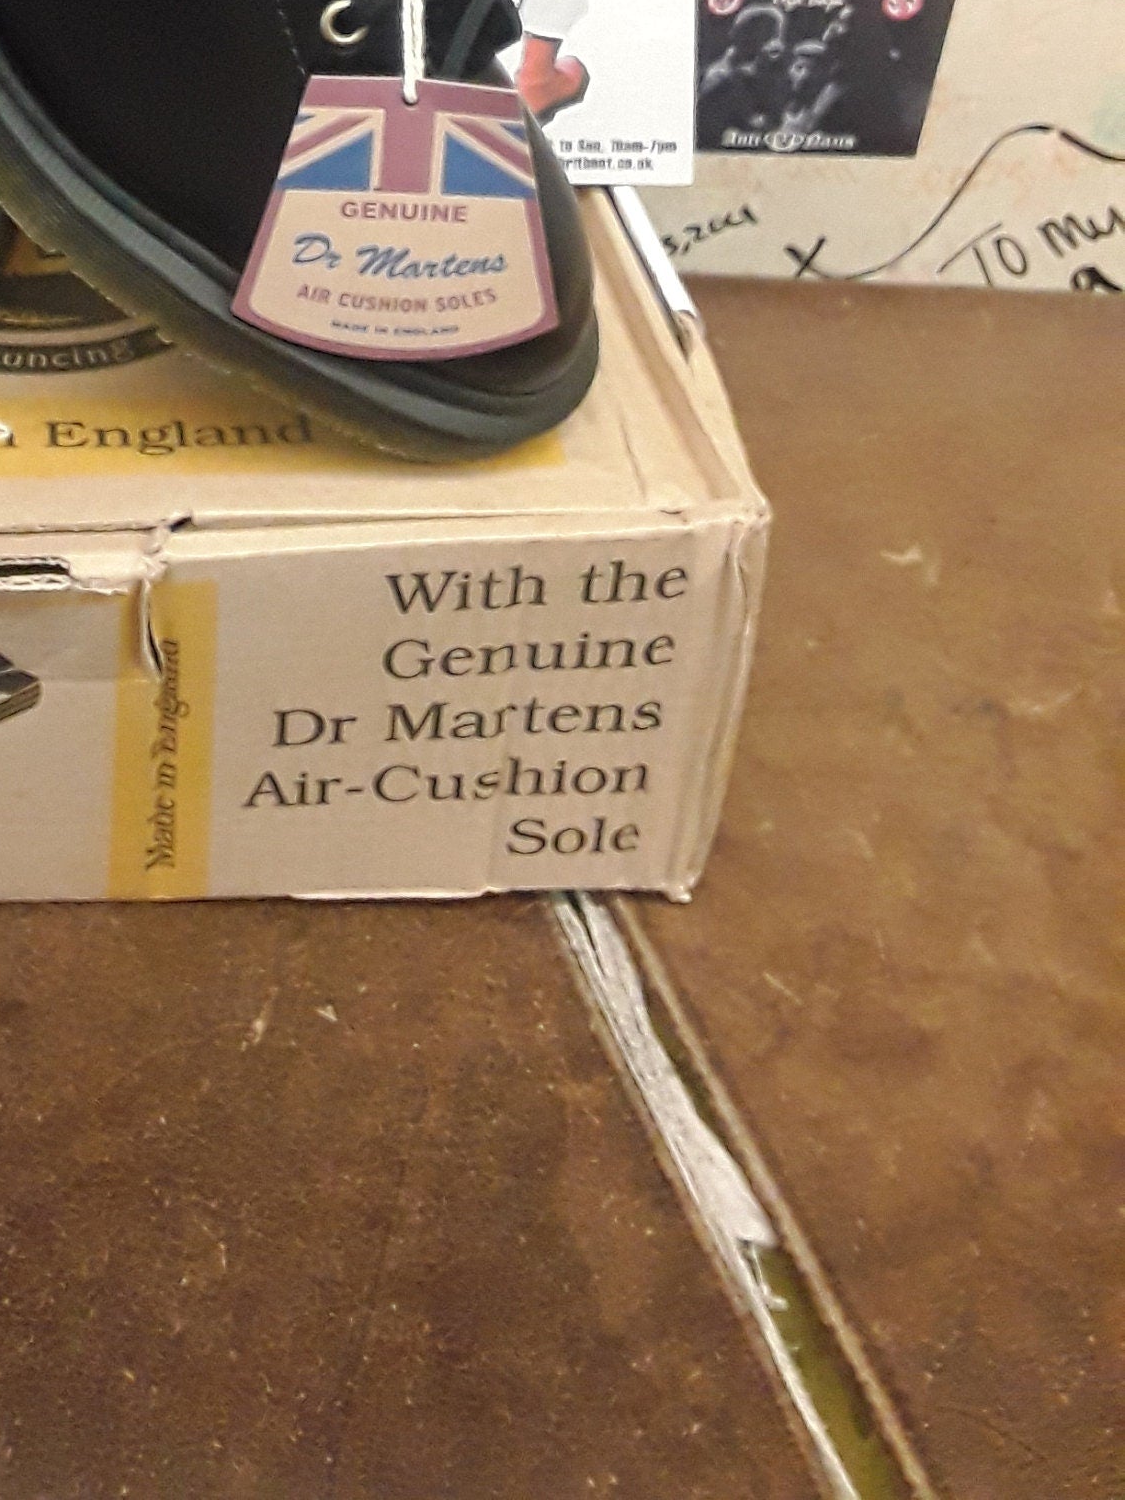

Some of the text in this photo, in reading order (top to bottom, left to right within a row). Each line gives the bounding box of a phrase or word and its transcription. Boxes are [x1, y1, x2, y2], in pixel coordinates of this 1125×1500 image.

[340, 200, 469, 223] GENUINE
[291, 232, 509, 280] Dr Martens
[296, 283, 497, 314] AIR CUSHION SOLES
[44, 414, 315, 457] England
[383, 559, 689, 616] With the
[382, 631, 677, 681] Genuine
[272, 695, 665, 749] Dr Martens
[242, 755, 652, 809] Air-Cushion
[505, 815, 643, 858] Sole
